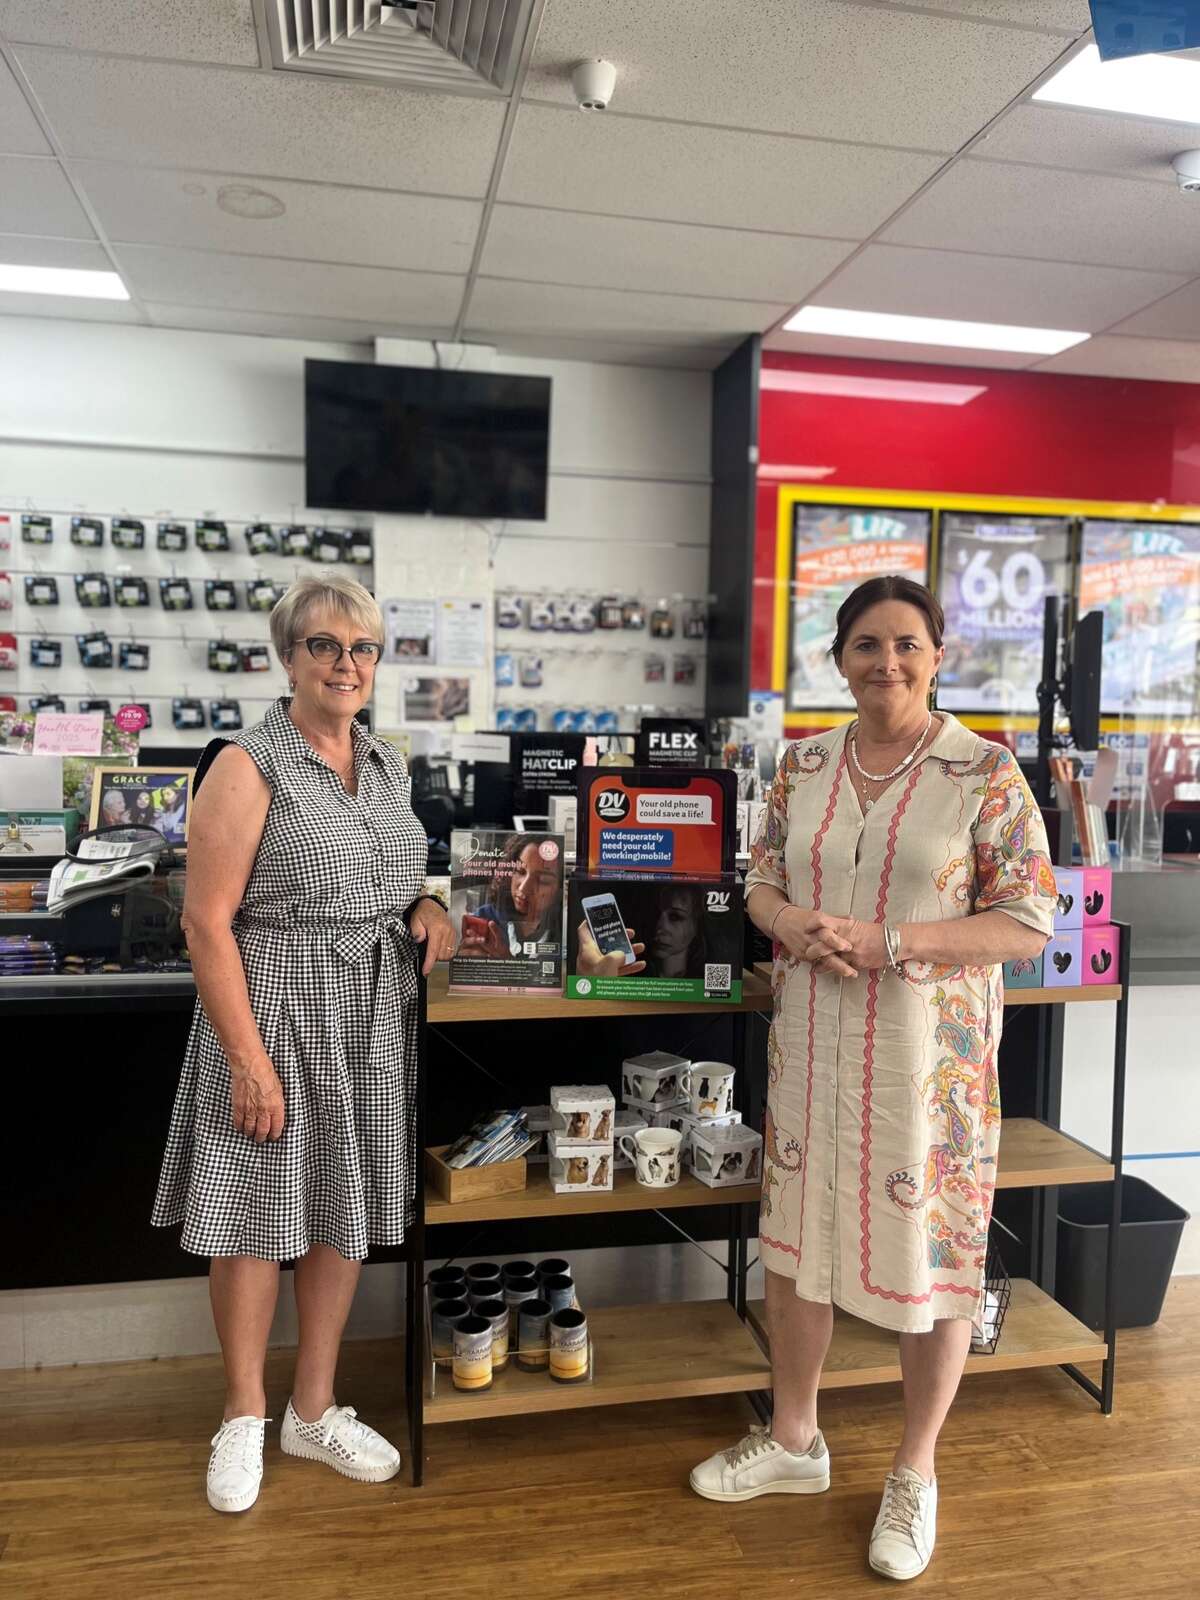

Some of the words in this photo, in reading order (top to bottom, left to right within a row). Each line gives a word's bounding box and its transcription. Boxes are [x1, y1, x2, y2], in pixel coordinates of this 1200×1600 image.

[649, 732, 698, 749] FLEX
[522, 758, 577, 770] HATCLIP
[112, 775, 149, 784] GRACE
[599, 792, 626, 808] DV
[640, 800, 659, 808] Your
[659, 800, 673, 809] old
[673, 800, 699, 811] phone
[640, 810, 661, 818] could
[687, 810, 704, 818] life!
[602, 832, 615, 840] We
[616, 832, 664, 843] desperately
[602, 842, 622, 850] need
[623, 843, 641, 852] your
[642, 841, 656, 850] old
[484, 859, 497, 868] old
[498, 860, 527, 869] mobile
[462, 868, 493, 878] phones
[494, 869, 514, 877] here
[706, 891, 731, 905] DV
